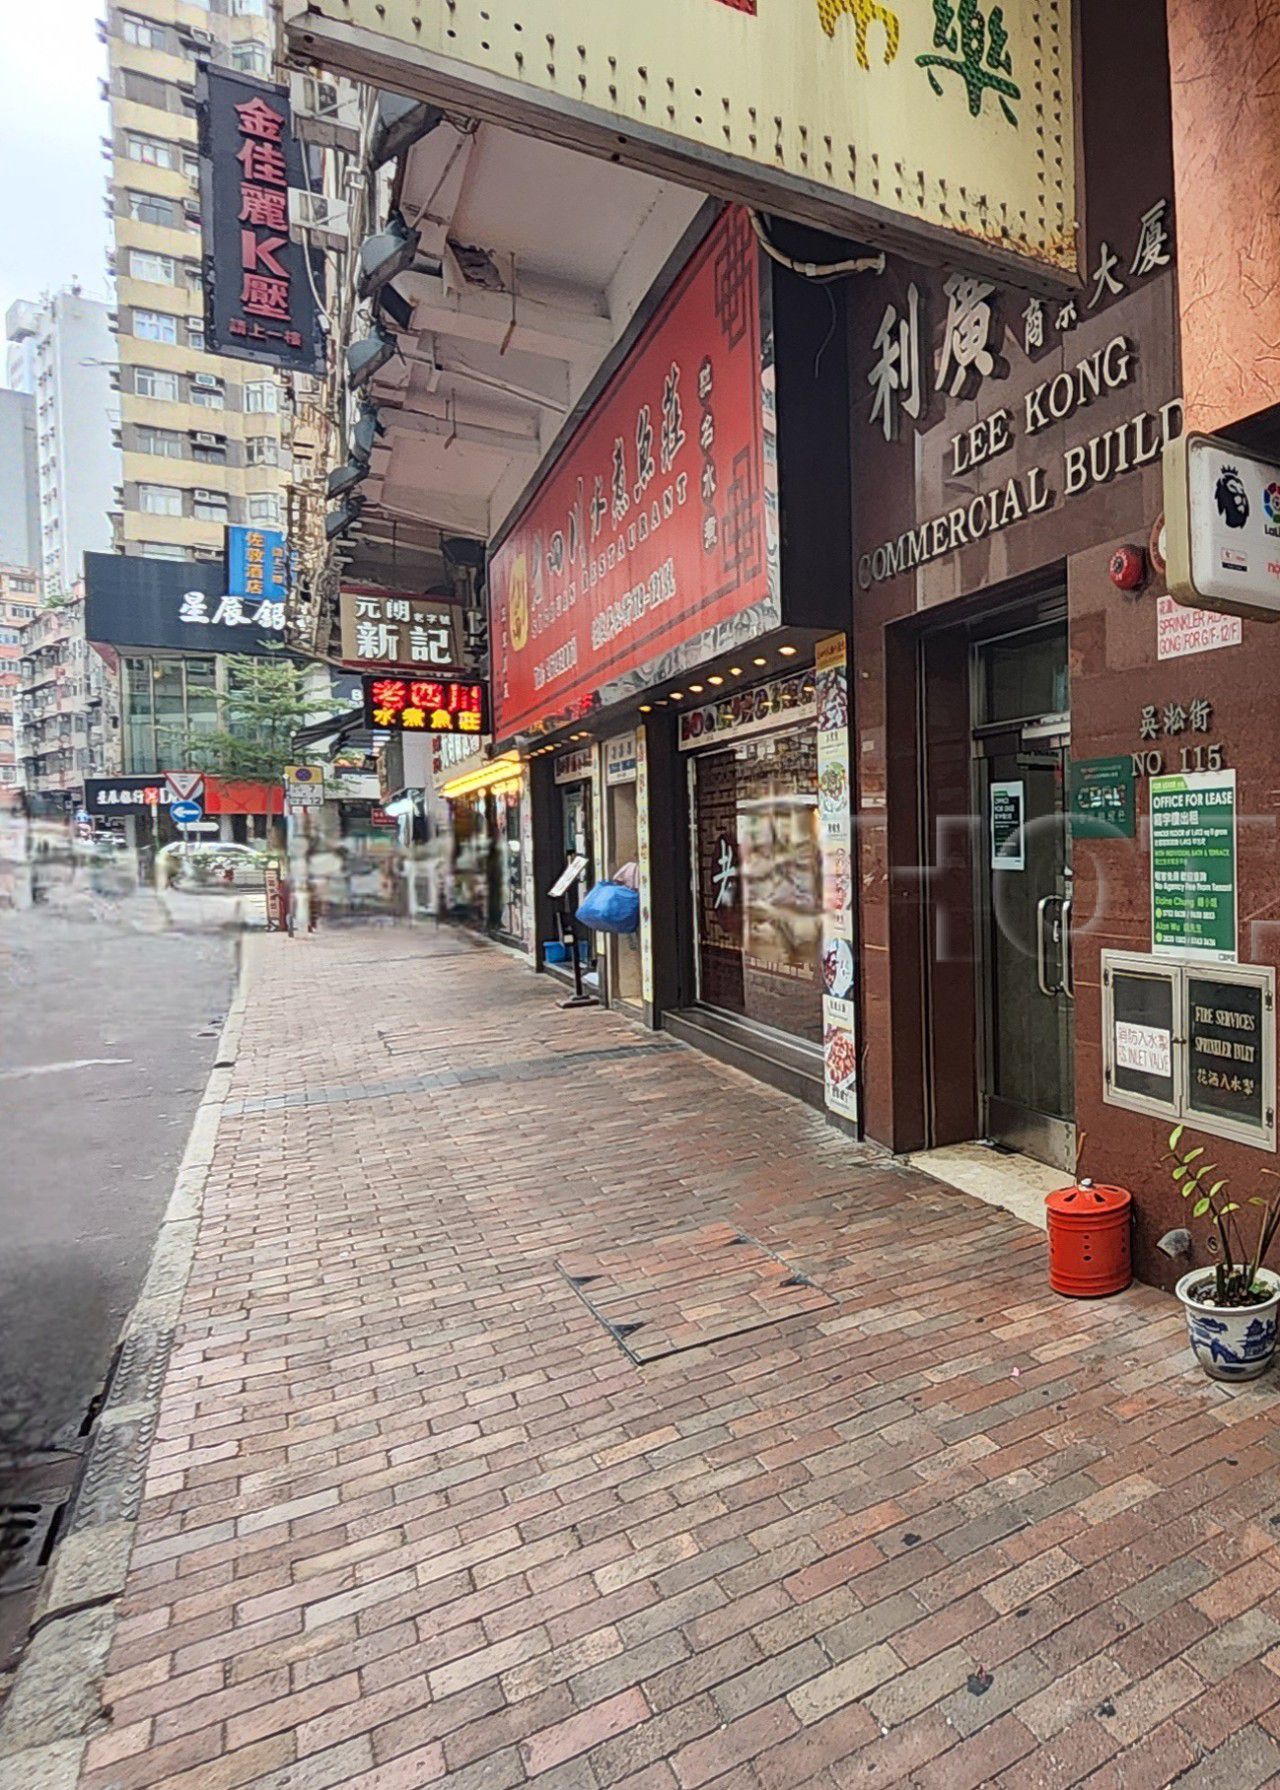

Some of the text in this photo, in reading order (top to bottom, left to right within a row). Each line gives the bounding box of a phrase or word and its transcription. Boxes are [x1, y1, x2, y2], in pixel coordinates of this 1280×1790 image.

[952, 335, 1131, 476] LEE KONG
[857, 467, 1049, 591] COMMERCIAL
[357, 622, 452, 664] 新記
[1132, 751, 1162, 776] NO
[1180, 744, 1222, 773] 115
[1153, 791, 1233, 809] OFFICE FOR LEASE
[1196, 1006, 1255, 1031] FIRE SERVICES
